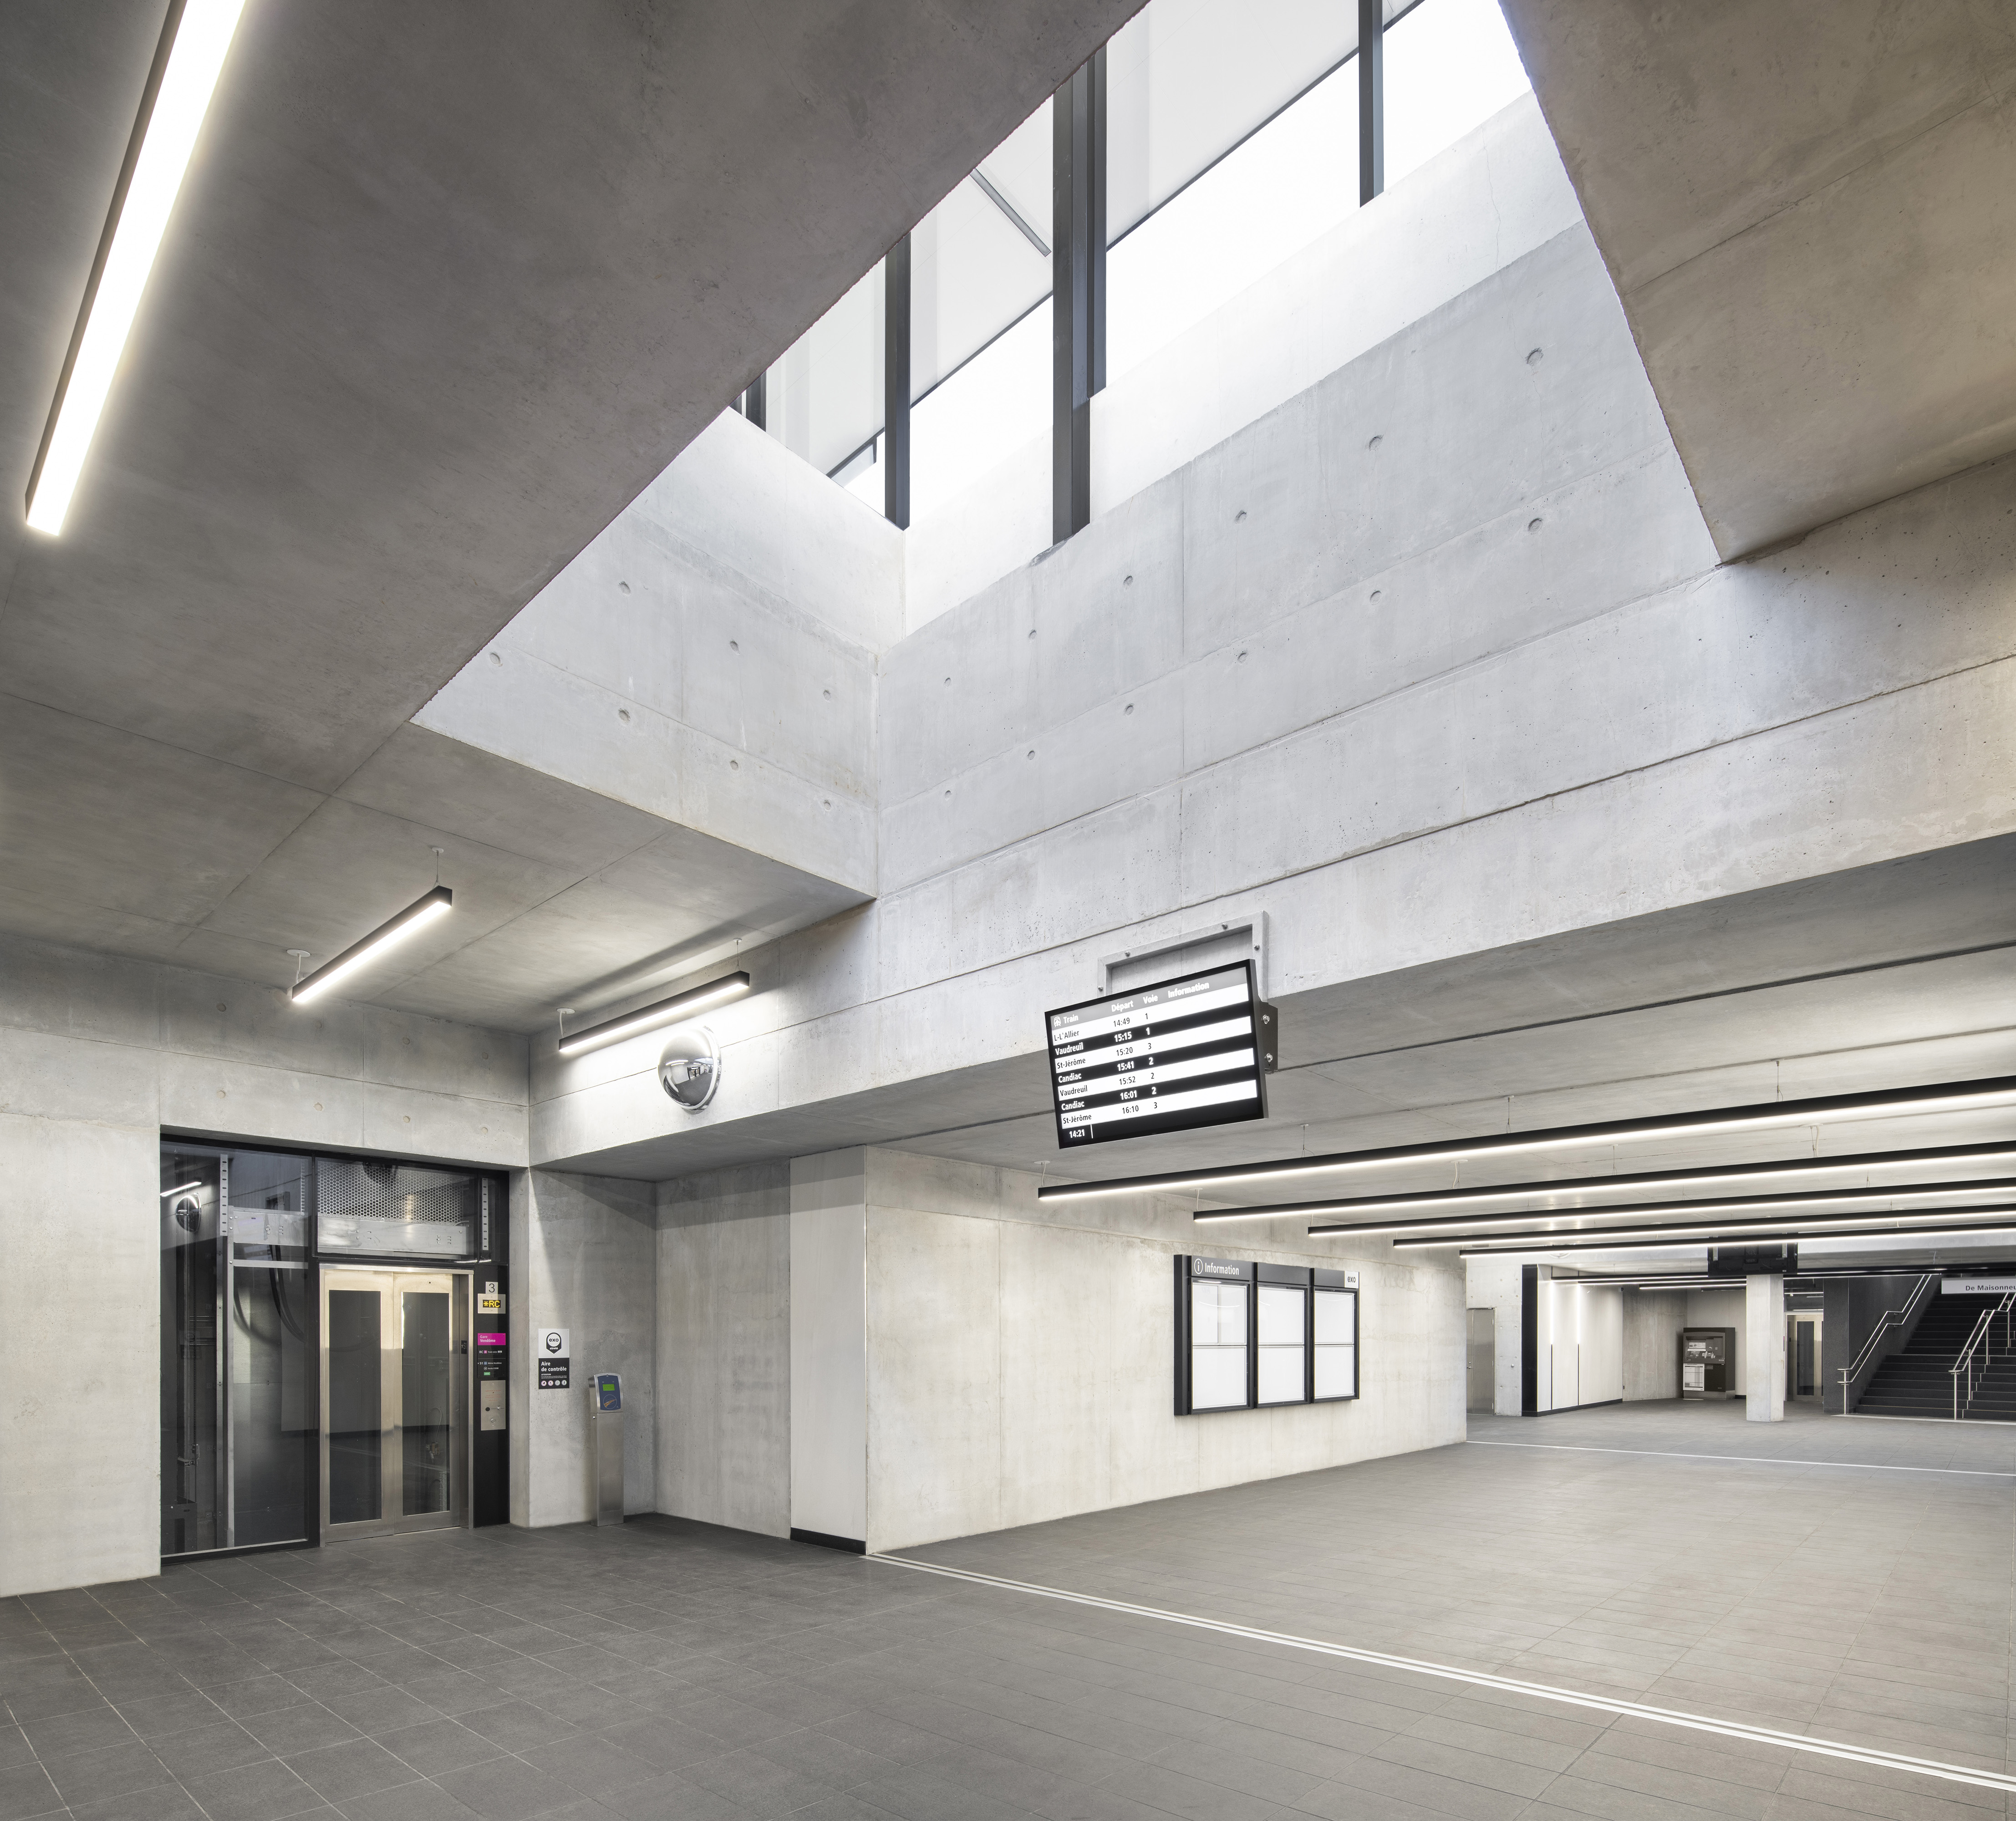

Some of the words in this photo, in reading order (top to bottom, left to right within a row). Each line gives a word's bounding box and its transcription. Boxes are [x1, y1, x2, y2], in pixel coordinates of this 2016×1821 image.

[1063, 1014, 1079, 1023] Train
[1111, 1000, 1134, 1012] Départ
[1143, 994, 1158, 1004] Voie
[1168, 982, 1210, 998] Information
[1054, 1031, 1079, 1041] L-L'Allier
[1113, 1017, 1130, 1027] 14:49
[1055, 1042, 1084, 1055] Vaudreuil
[1114, 1031, 1132, 1042] 15:15
[1146, 1027, 1150, 1035] 1
[1057, 1058, 1085, 1069] St-Jérôme
[1116, 1047, 1133, 1056] 15:20
[1058, 1073, 1082, 1083] Candiac
[1117, 1061, 1134, 1071] 15:41
[1149, 1057, 1154, 1065] 2
[1060, 1085, 1088, 1096] Vaudreuil
[1120, 1076, 1135, 1085] 15:52
[1061, 1101, 1084, 1110] Candiac
[1120, 1090, 1137, 1100] 16:01
[1151, 1087, 1156, 1095] 2
[1063, 1114, 1092, 1124] St-Jérôme
[1122, 1105, 1139, 1114] 16:10
[1069, 1129, 1085, 1138] 14:21
[1205, 1262, 1239, 1275] Information
[489, 1283, 495, 1293] 3
